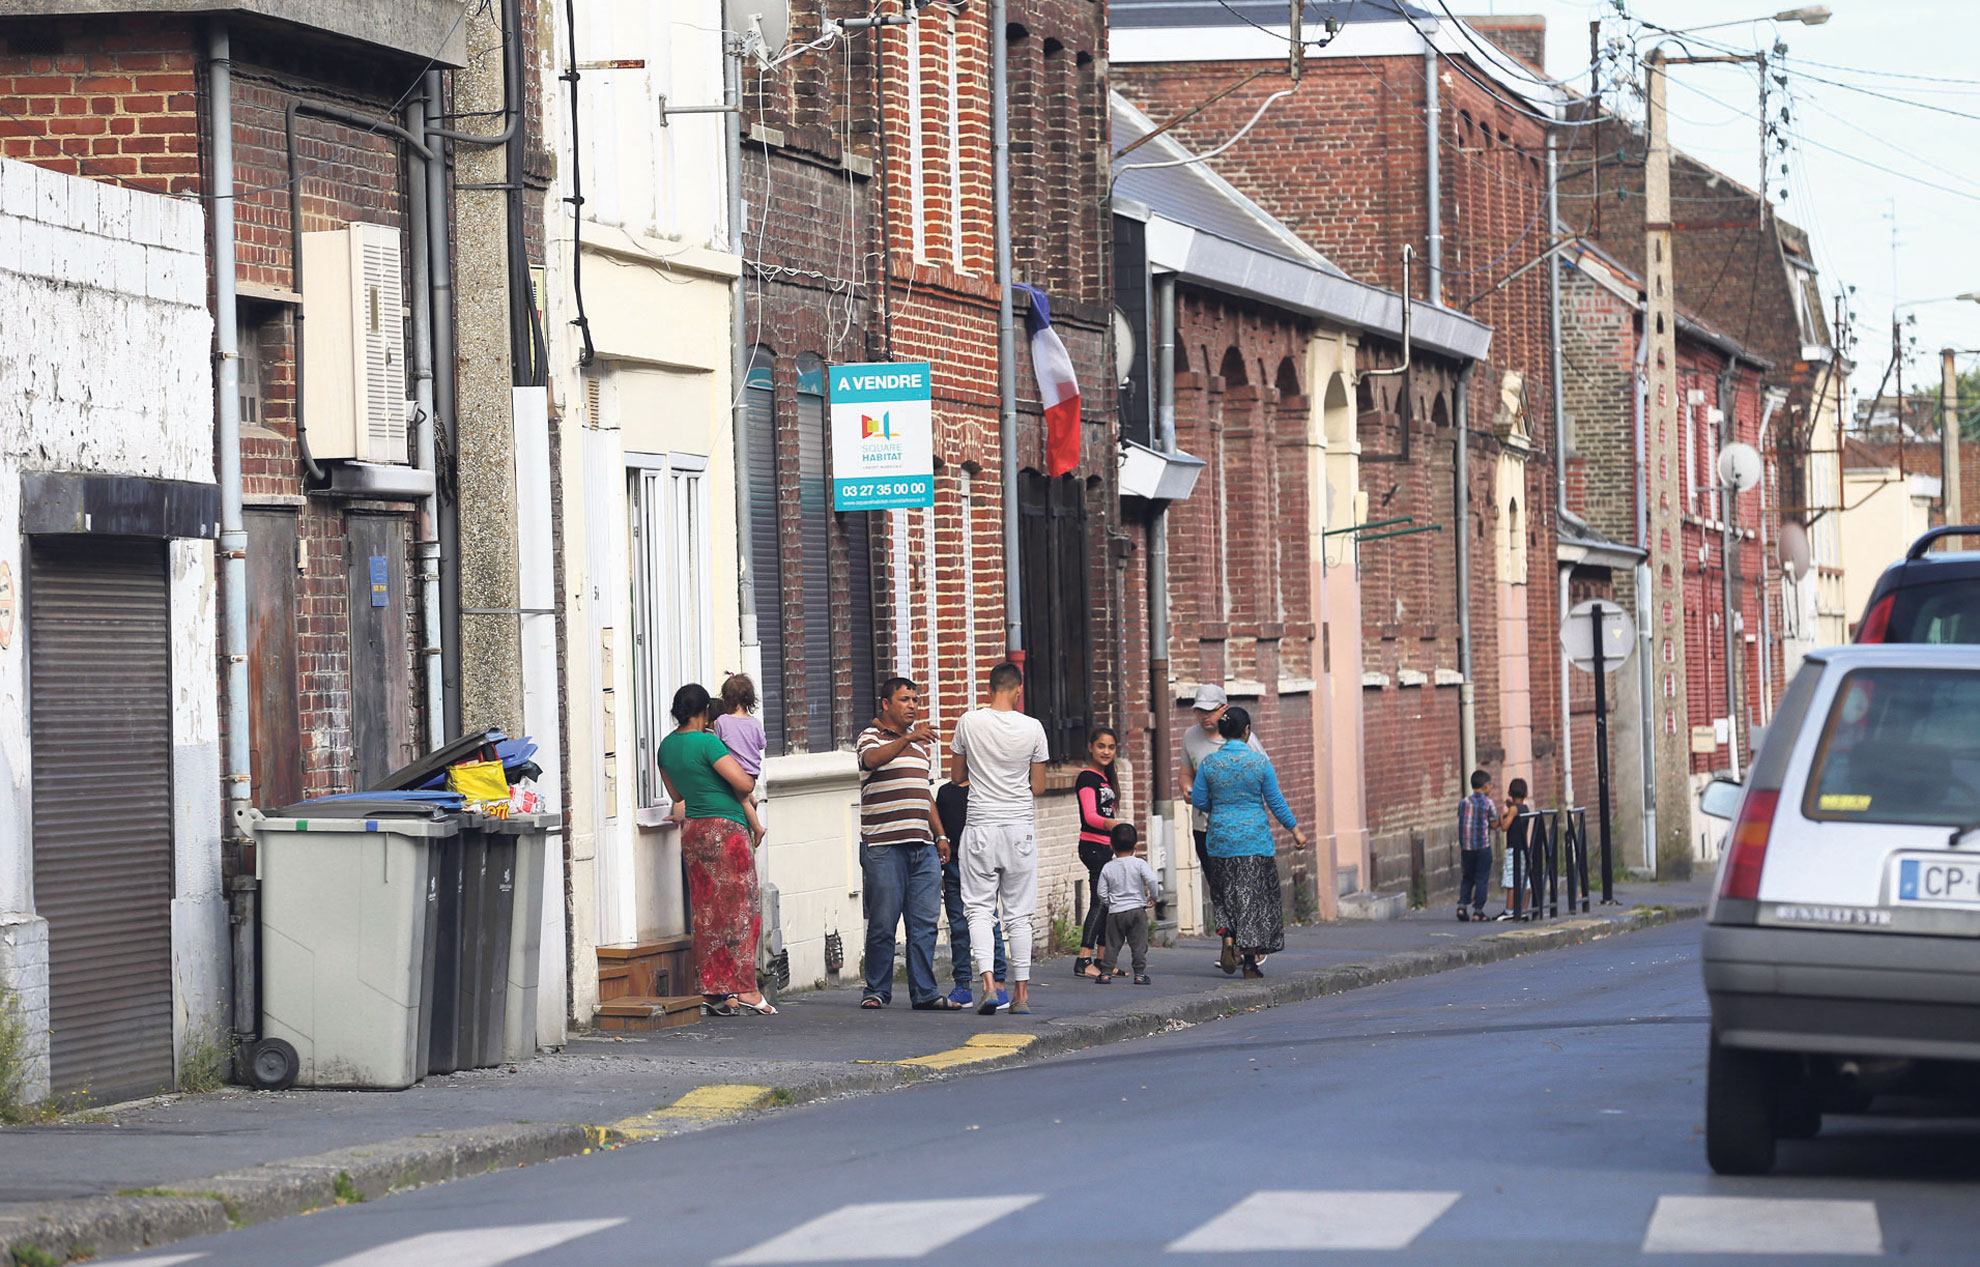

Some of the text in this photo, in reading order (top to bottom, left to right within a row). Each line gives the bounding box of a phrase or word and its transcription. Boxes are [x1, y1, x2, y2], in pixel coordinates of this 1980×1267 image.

[838, 374, 922, 391] A VENDRE
[862, 443, 902, 453] SQUARE
[862, 453, 902, 462] HABITAT
[843, 483, 925, 497] 03 27 35 00 00
